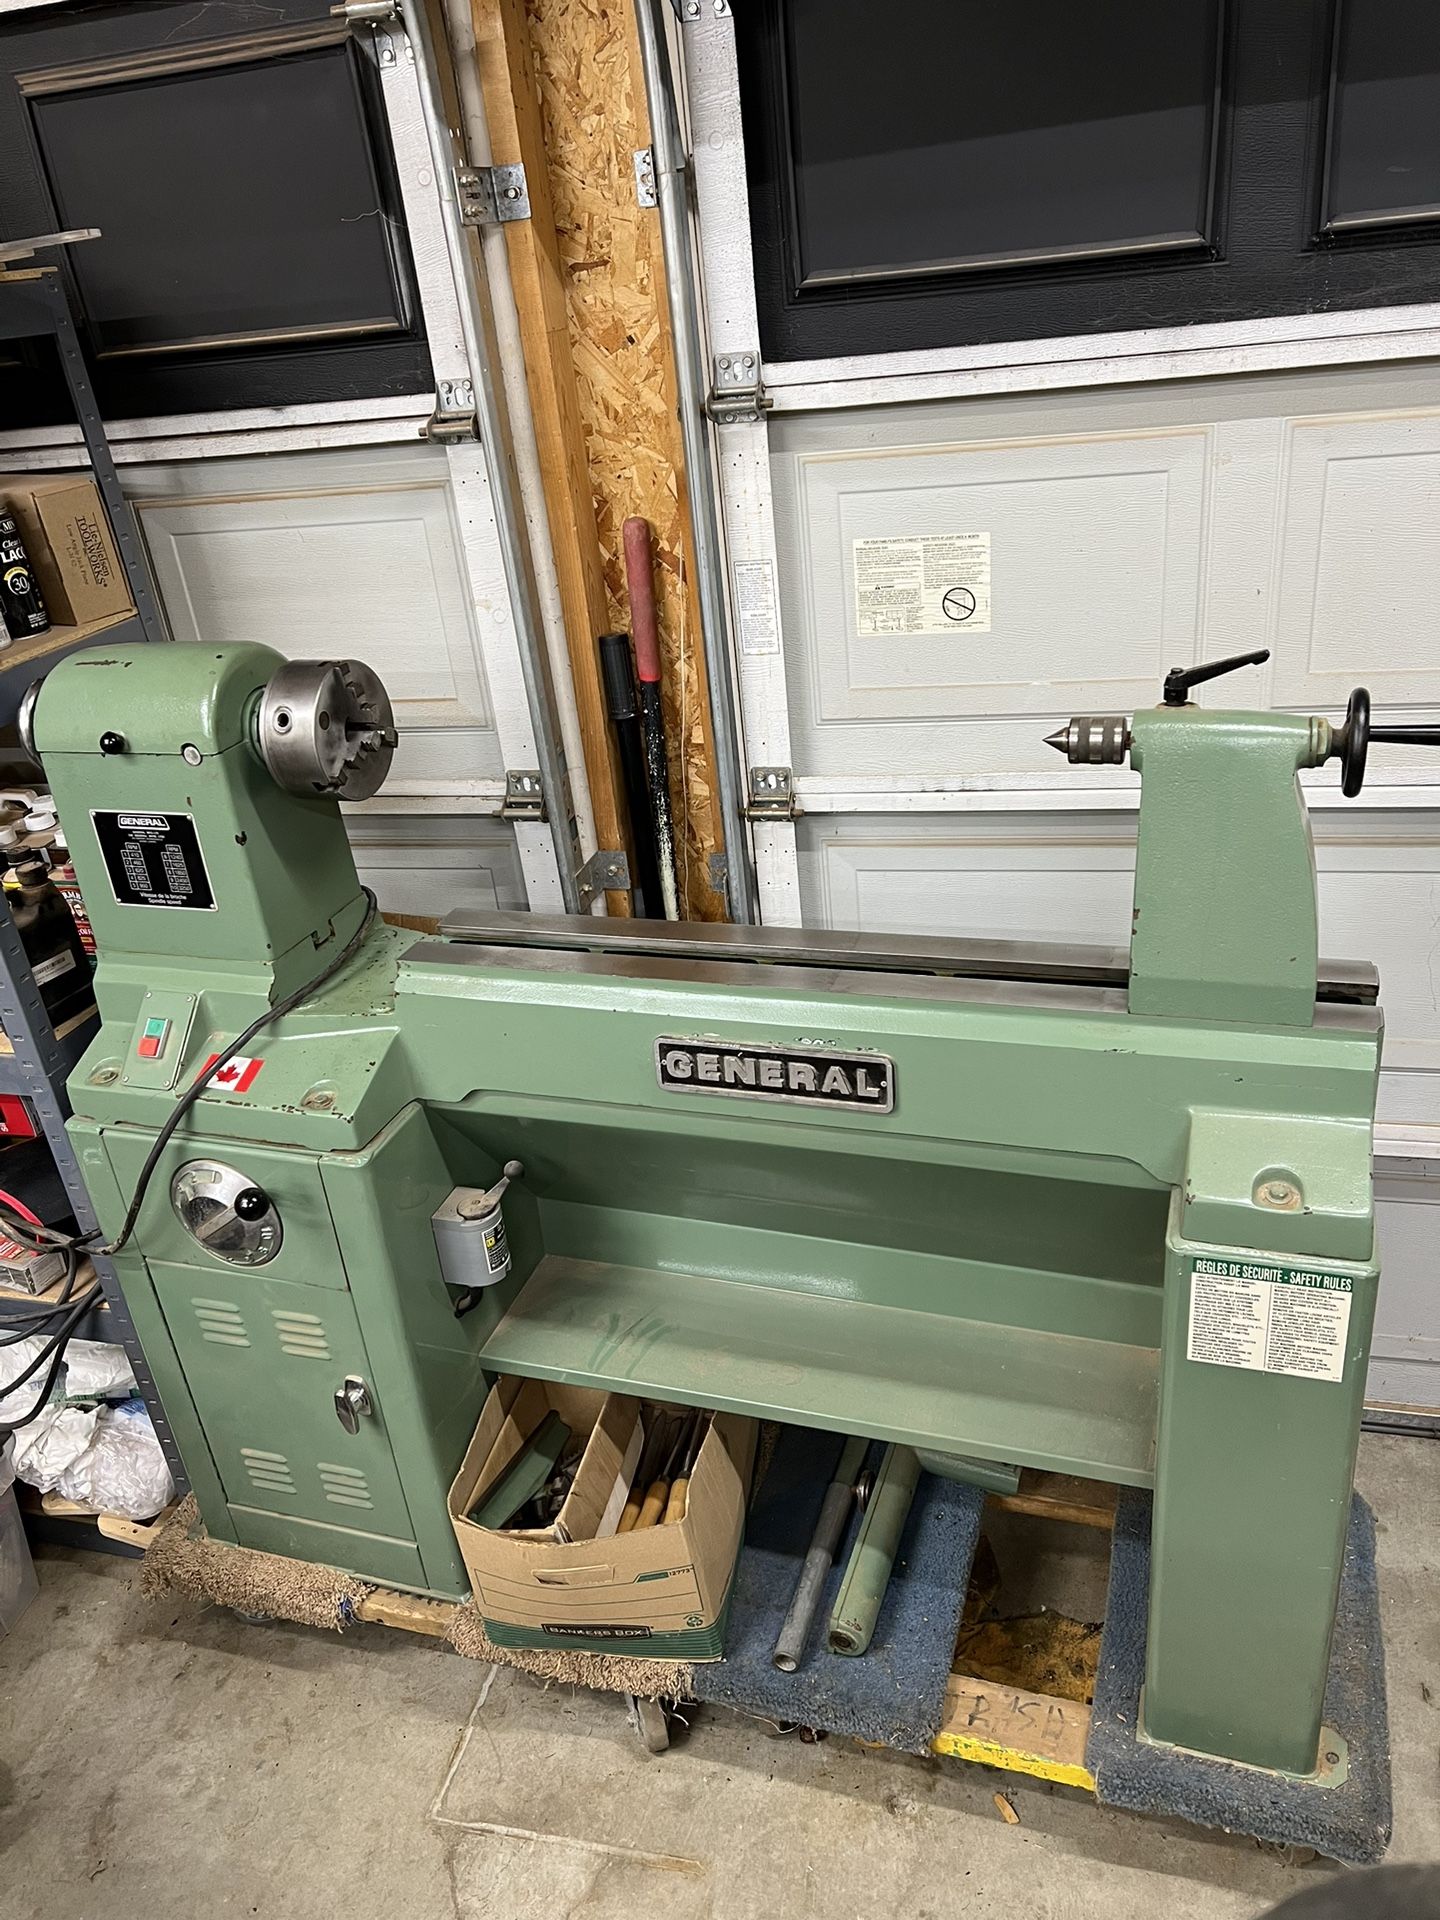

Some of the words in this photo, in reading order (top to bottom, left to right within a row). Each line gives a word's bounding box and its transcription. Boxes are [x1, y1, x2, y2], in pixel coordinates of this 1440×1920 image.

[12, 576, 28, 591] 30
[120, 817, 166, 827] GENERAL
[665, 1049, 881, 1098] GENERAL
[1230, 1264, 1240, 1277] DE
[1289, 1271, 1323, 1288] SAFETY
[1323, 1276, 1352, 1291] RULES
[550, 1627, 612, 1636] BANKERS
[615, 1629, 643, 1637] BOX
